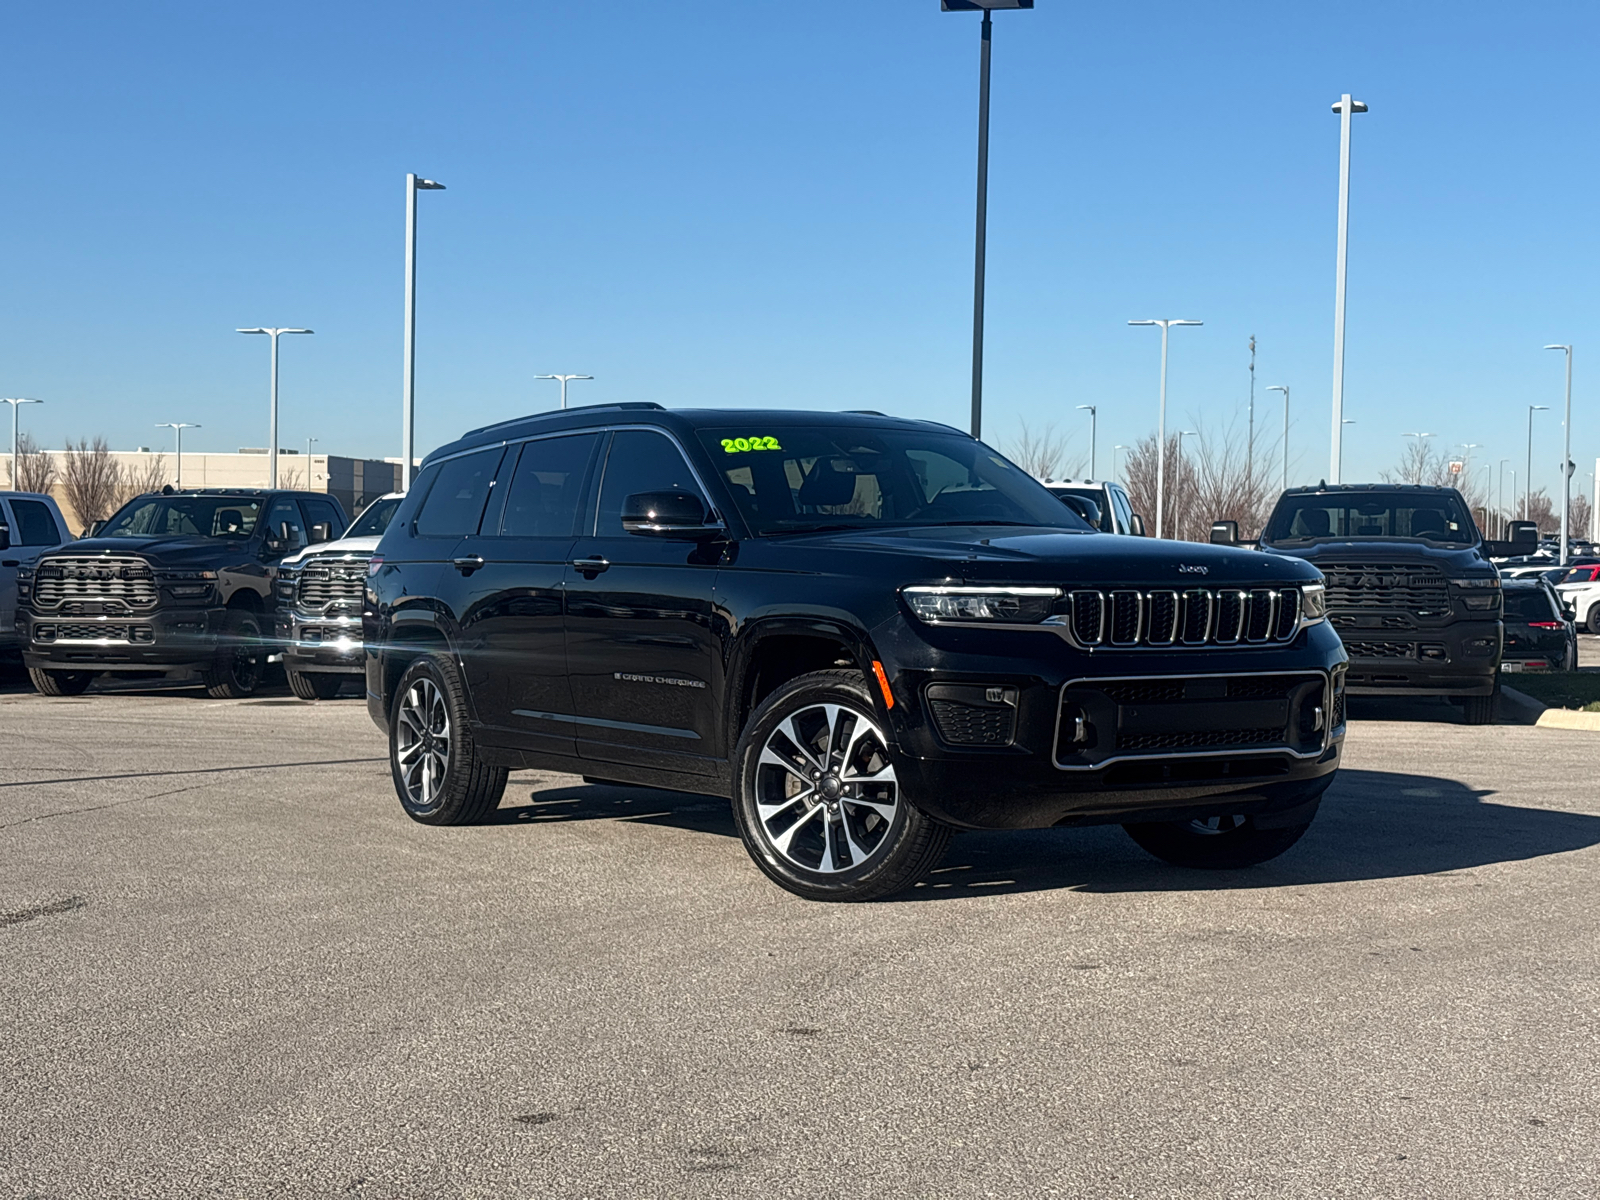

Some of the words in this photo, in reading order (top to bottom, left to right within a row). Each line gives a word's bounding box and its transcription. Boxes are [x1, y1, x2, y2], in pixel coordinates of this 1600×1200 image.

[721, 436, 781, 453] 2022
[63, 567, 121, 578] RAM
[1179, 563, 1209, 575] Jeep
[1330, 575, 1407, 586] RAM
